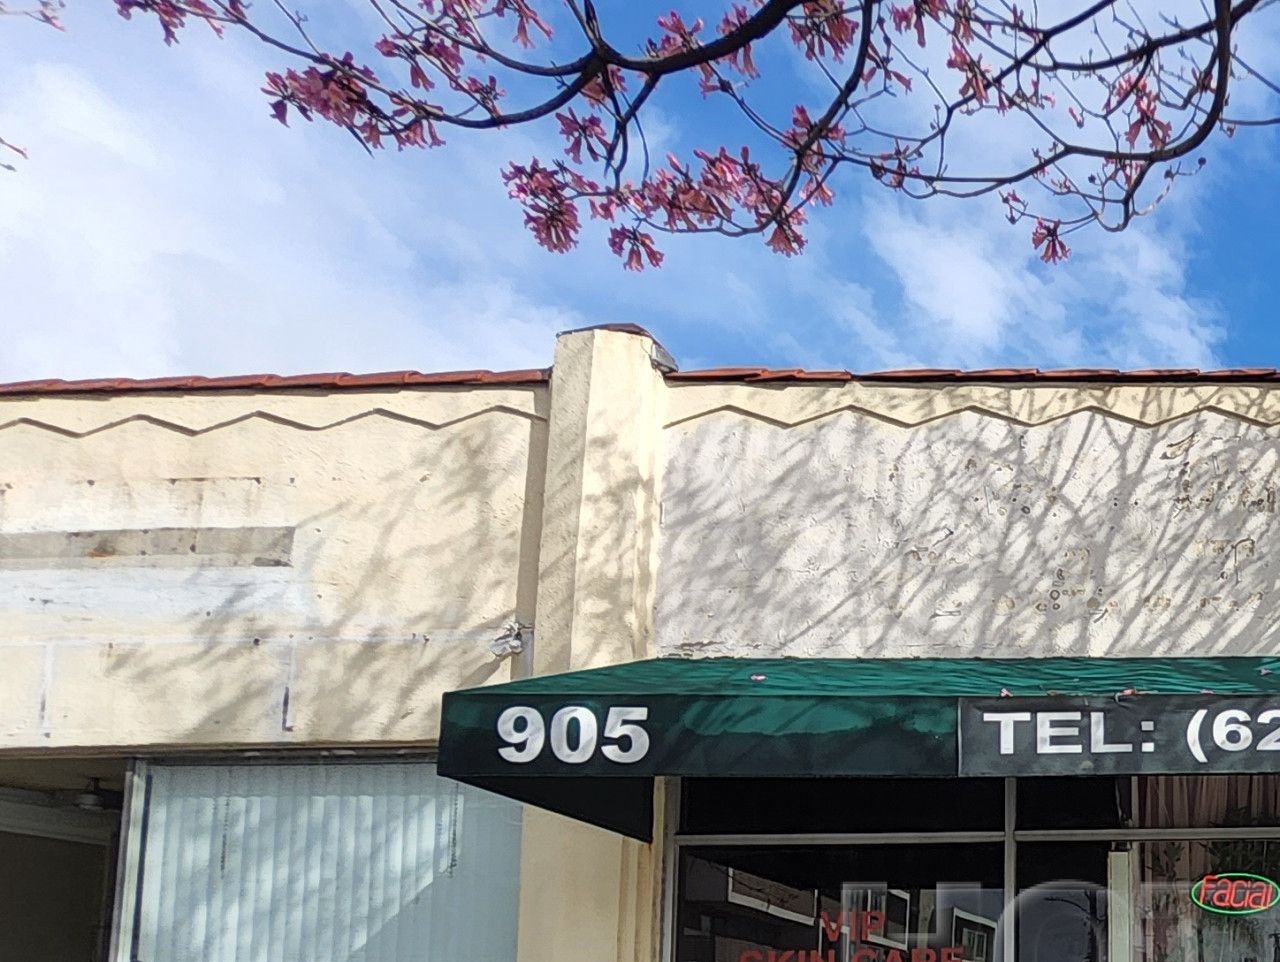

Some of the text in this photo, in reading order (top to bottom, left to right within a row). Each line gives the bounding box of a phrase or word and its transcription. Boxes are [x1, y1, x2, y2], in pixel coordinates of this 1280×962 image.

[497, 705, 650, 764] 905
[983, 711, 1155, 755] TEL:
[1200, 875, 1273, 910] Facial
[819, 911, 887, 943] VIP
